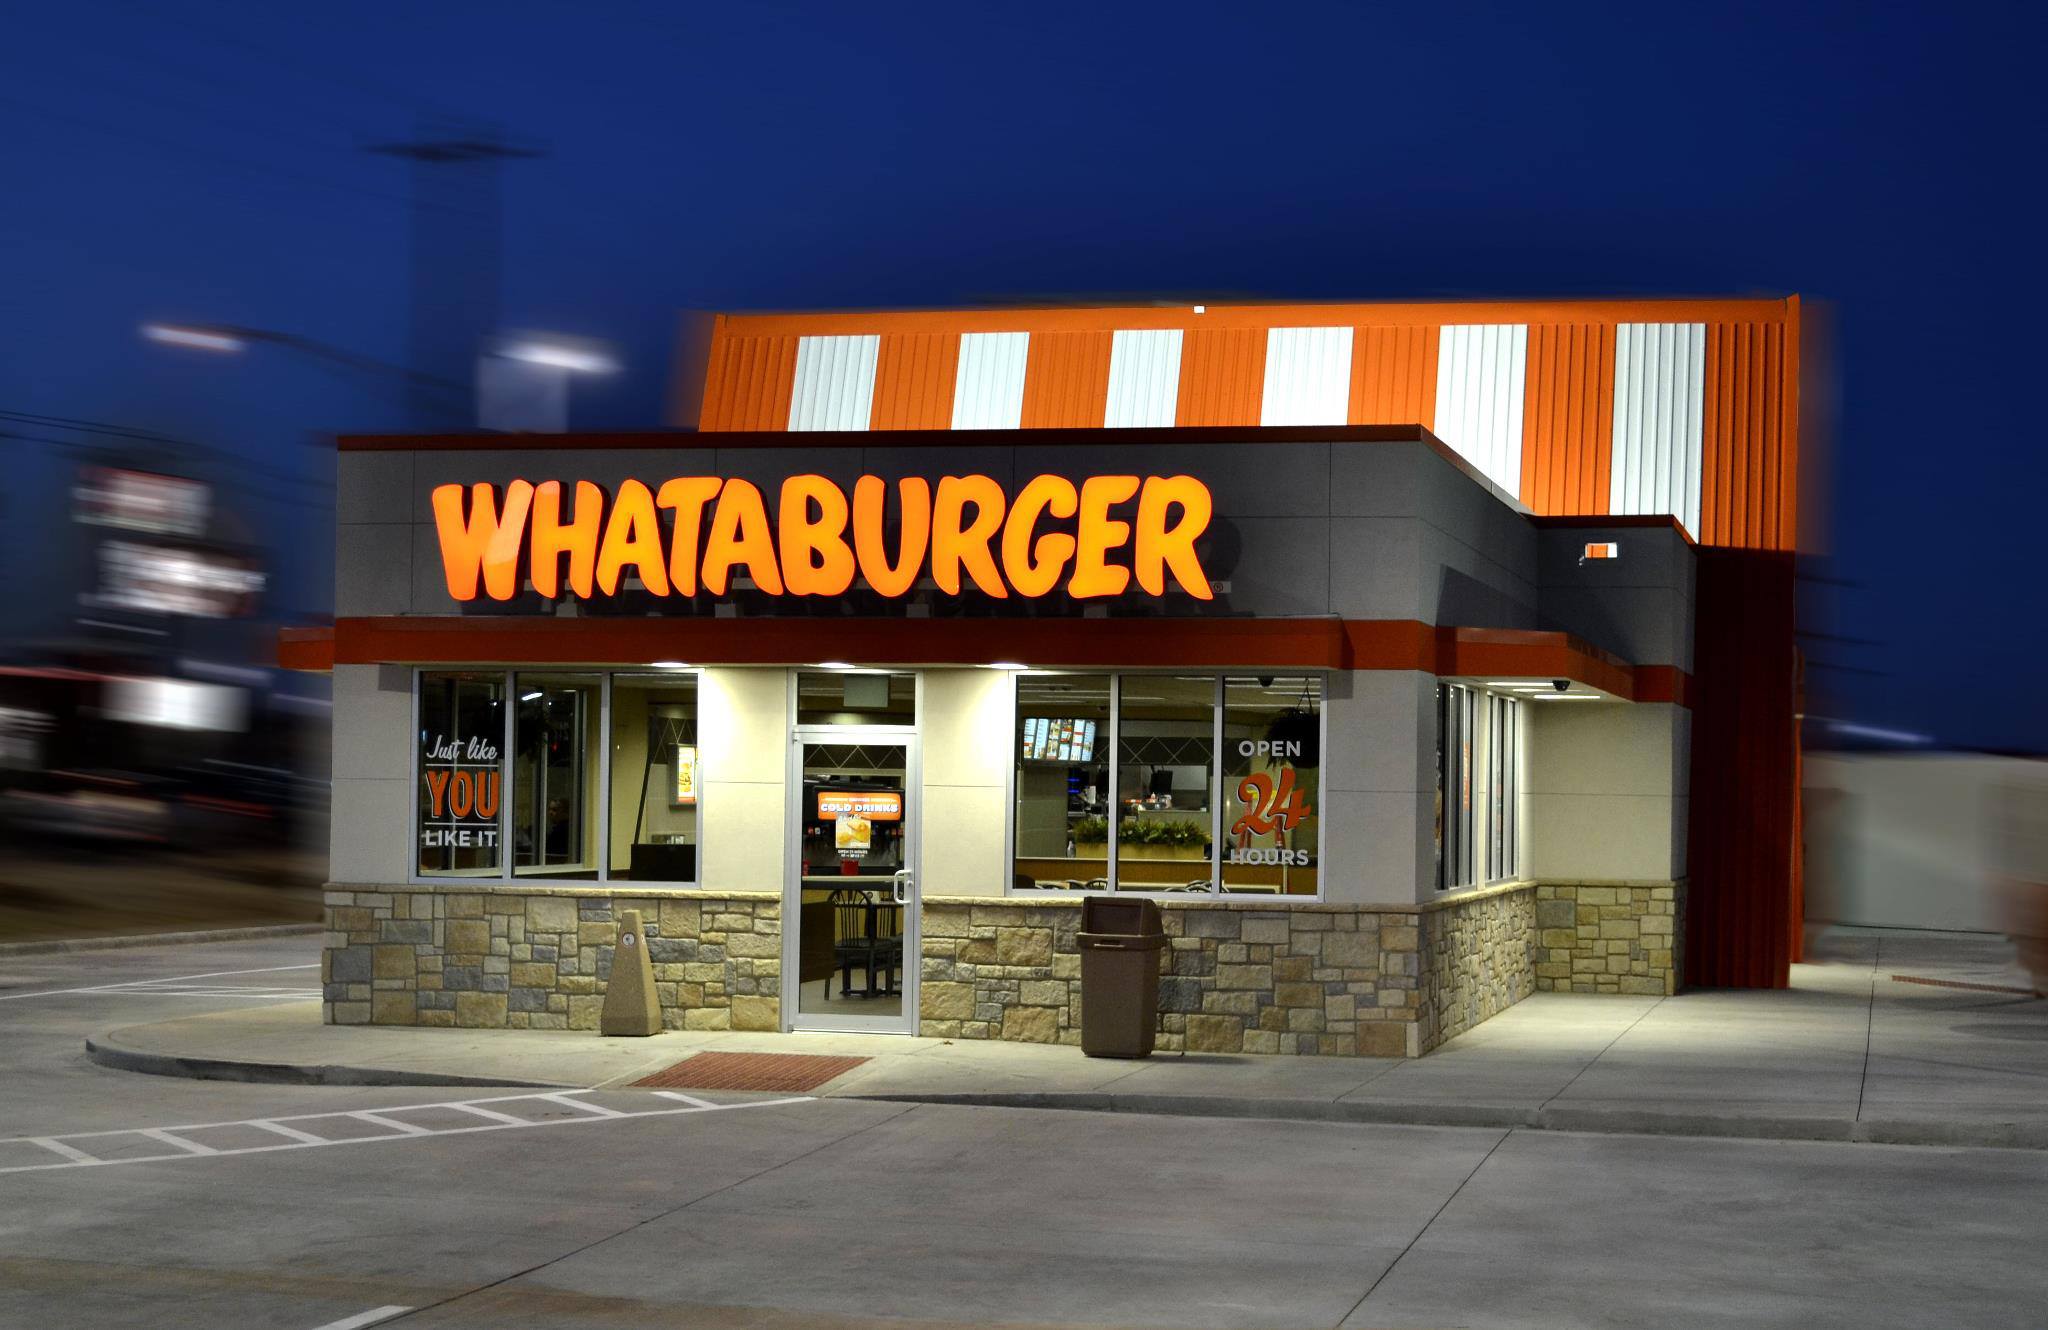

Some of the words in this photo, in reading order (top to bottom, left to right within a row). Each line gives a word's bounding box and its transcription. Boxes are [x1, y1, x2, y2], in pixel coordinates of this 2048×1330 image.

[431, 474, 1213, 600] WHATABURGER
[426, 735, 465, 760] Just
[467, 736, 498, 760] like
[1238, 741, 1301, 757] OPEN
[425, 770, 500, 819] YOU
[1230, 768, 1311, 836] 24
[820, 803, 852, 812] COLD
[854, 804, 898, 813] DRINKS
[425, 830, 471, 846] LIKE
[478, 831, 499, 847] IT.
[1230, 849, 1309, 866] HOURS
